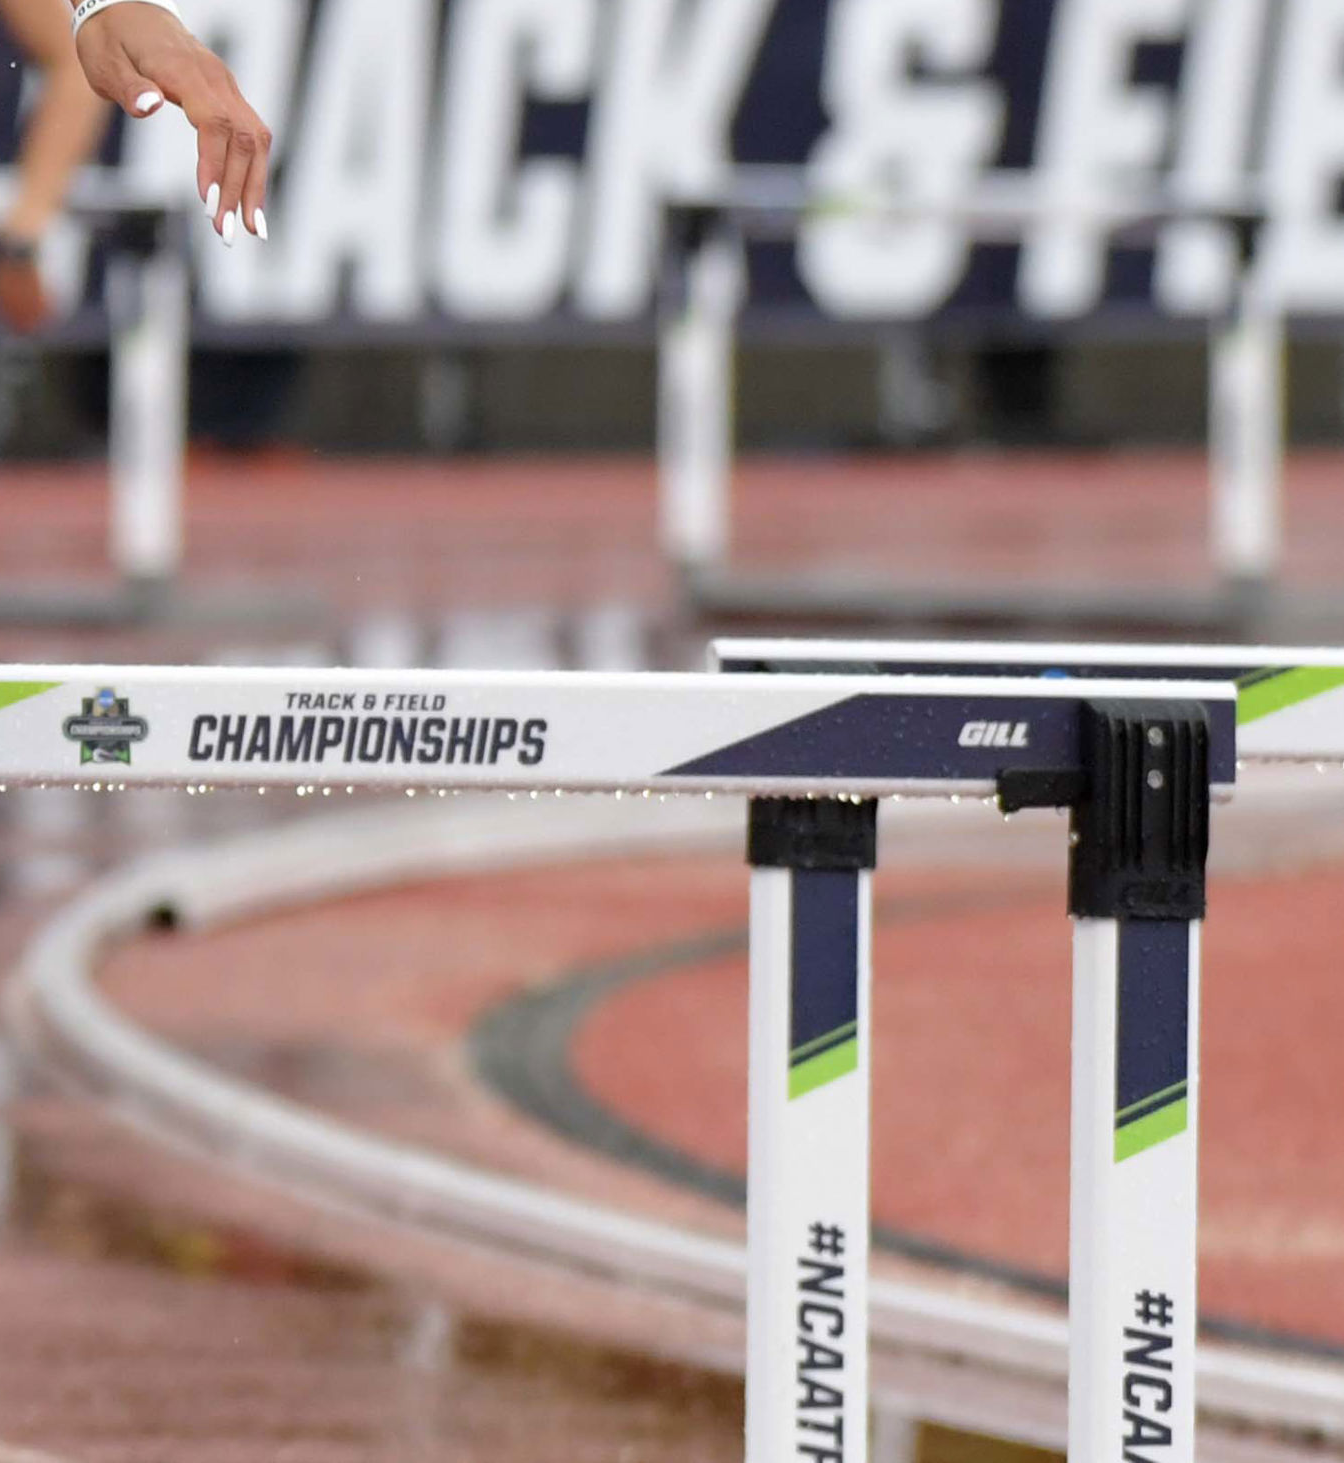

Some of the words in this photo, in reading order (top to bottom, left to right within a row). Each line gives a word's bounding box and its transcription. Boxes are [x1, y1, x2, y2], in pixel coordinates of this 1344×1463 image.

[286, 692, 356, 711] TRACK
[363, 694, 376, 711] &
[383, 694, 447, 712] FIELD
[187, 714, 548, 765] CHAMPIONSHIPS
[957, 721, 1029, 748] GILL
